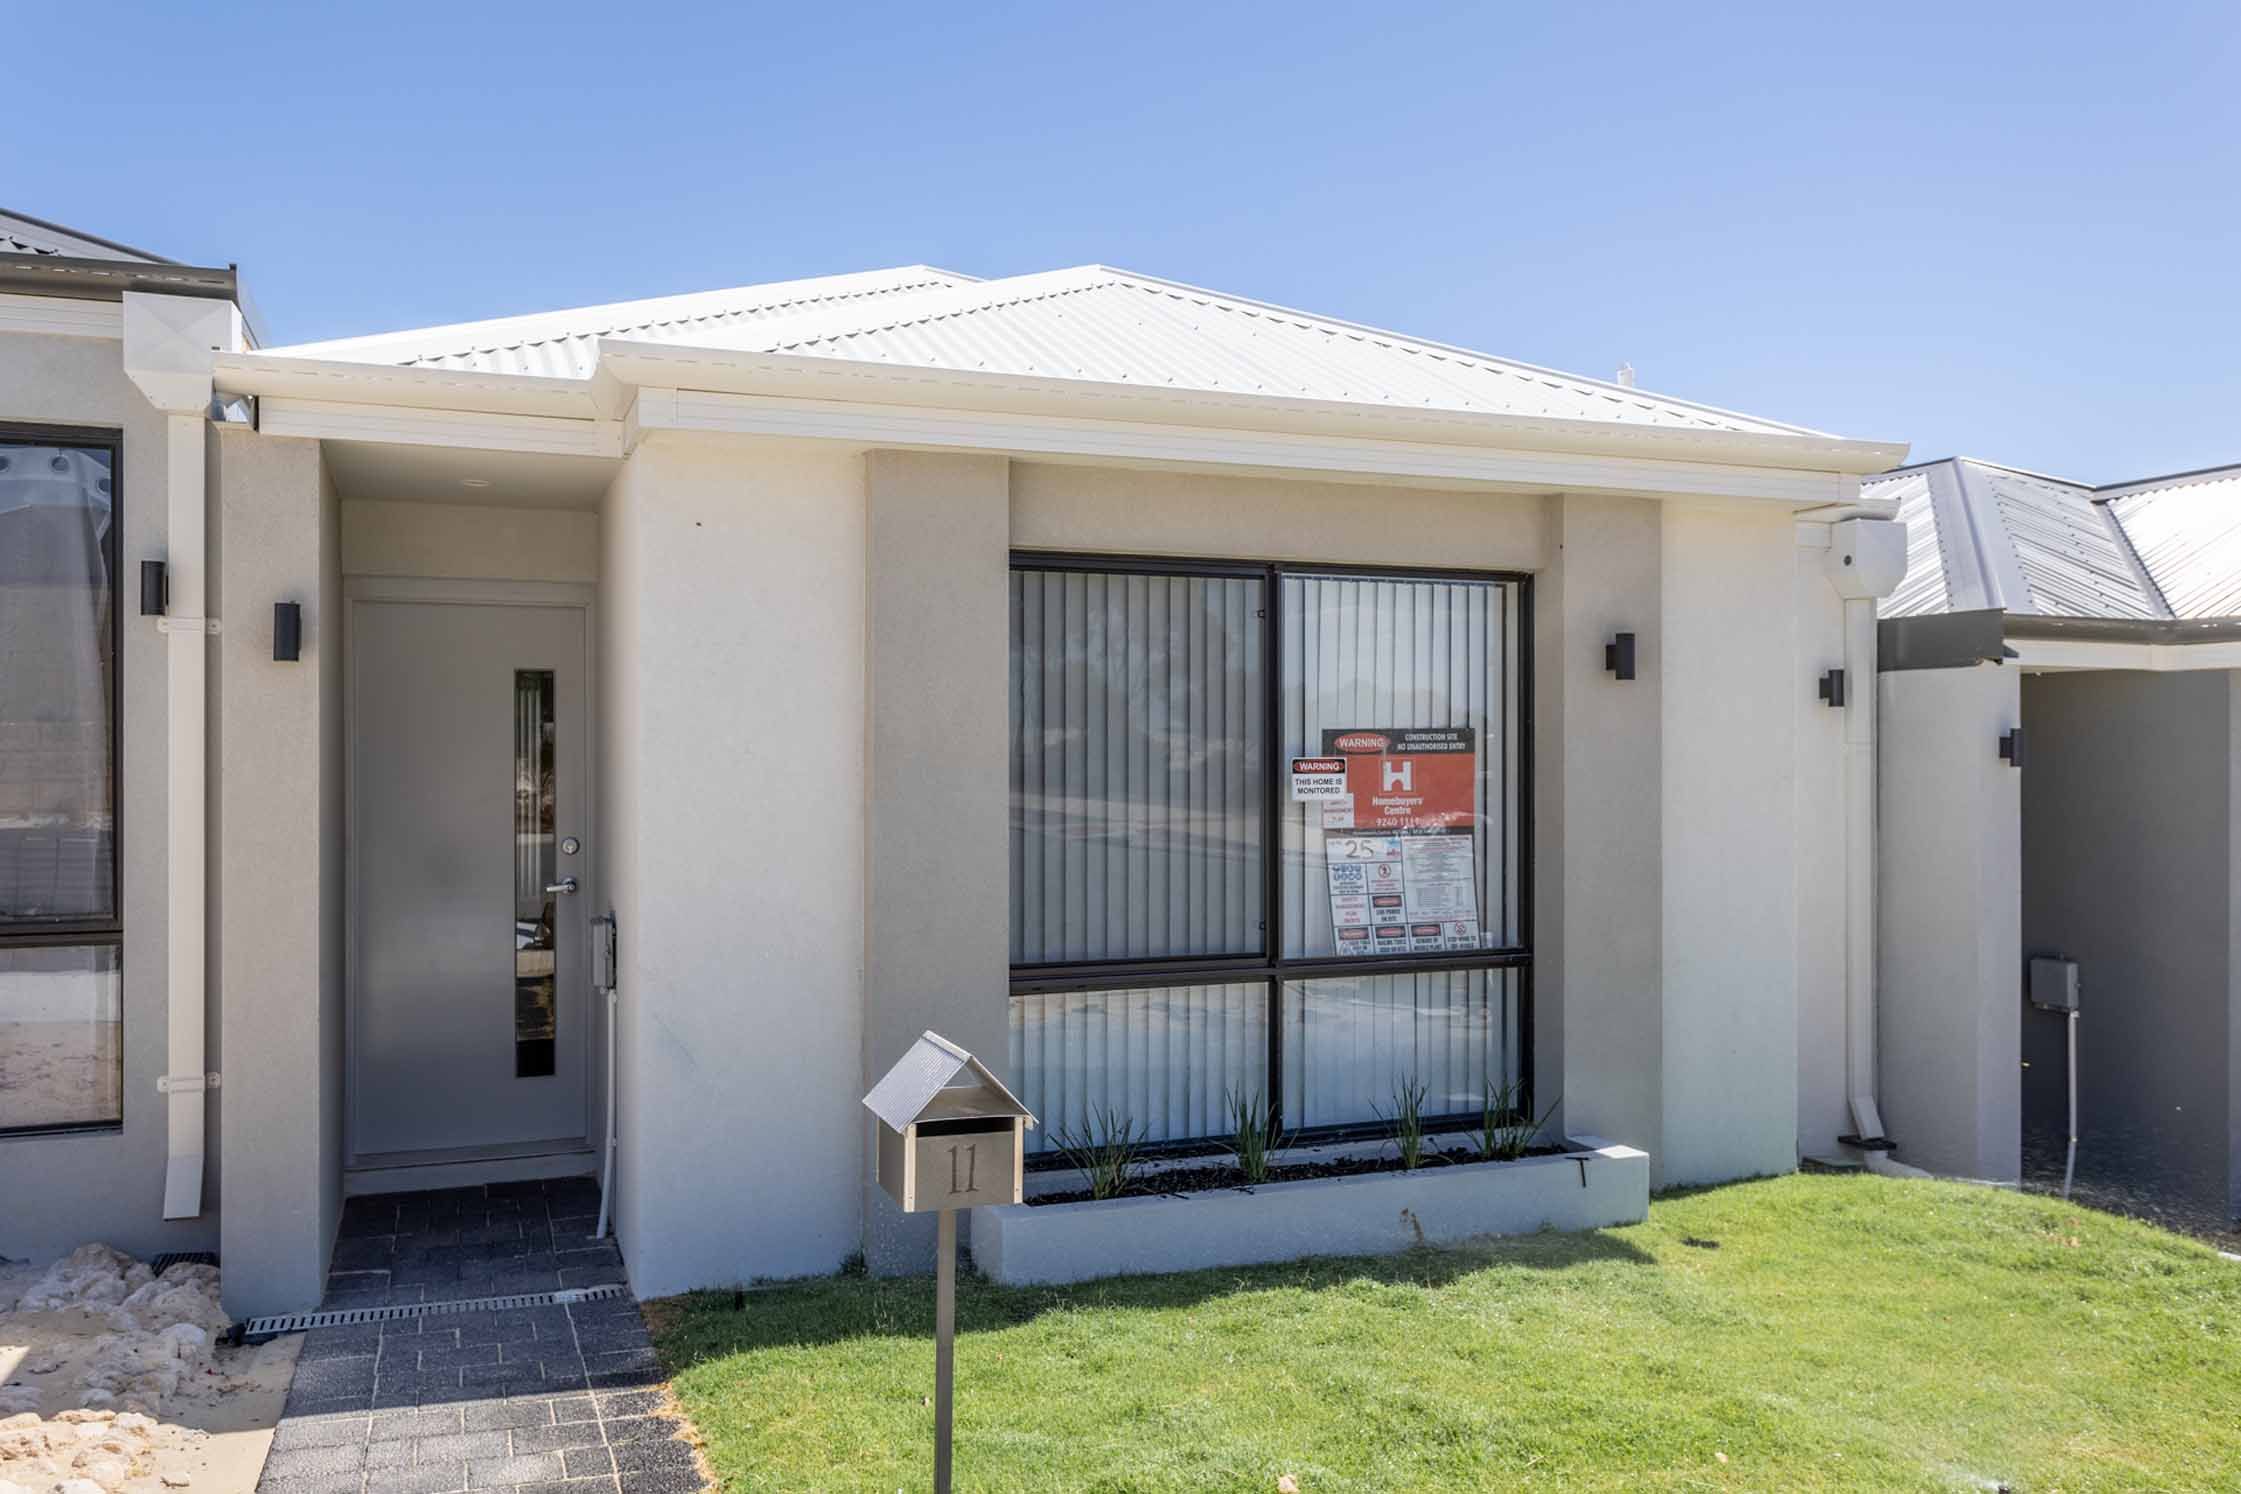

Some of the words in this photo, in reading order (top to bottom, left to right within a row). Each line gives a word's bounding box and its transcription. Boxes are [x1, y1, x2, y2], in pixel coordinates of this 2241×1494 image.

[1405, 733, 1445, 741] CONSTRUCTION
[1447, 733, 1458, 741] SITE
[1339, 736, 1386, 749] WARNING
[1407, 742, 1448, 751] UNAUTHORISED
[1449, 742, 1465, 750] ENTRY
[1299, 761, 1341, 771] WARNING
[1297, 786, 1341, 794] MONITORED
[1376, 817, 1398, 826] 9240
[1344, 839, 1375, 860] 25
[946, 1144, 980, 1194] 11
